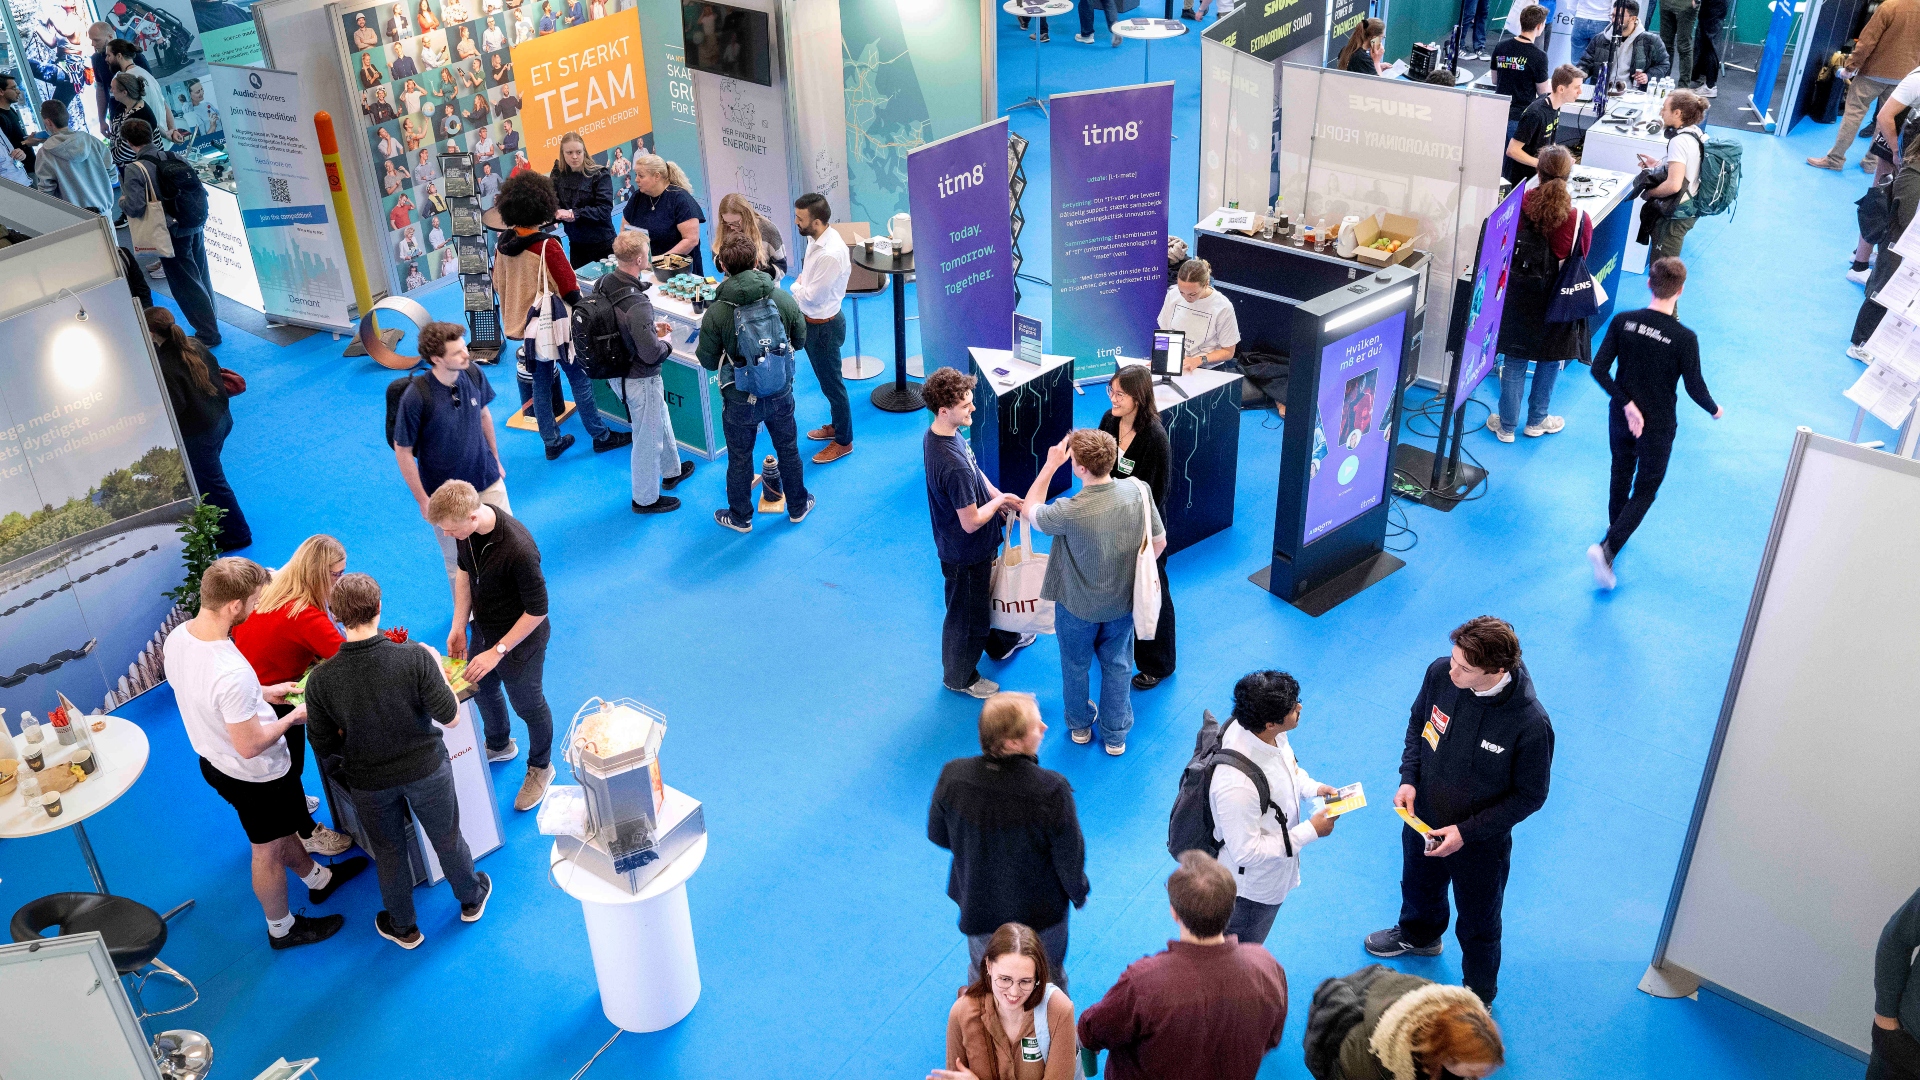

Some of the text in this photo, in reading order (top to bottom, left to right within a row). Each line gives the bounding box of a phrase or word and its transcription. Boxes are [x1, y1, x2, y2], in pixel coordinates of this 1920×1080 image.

[1250, 12, 1312, 53] EXTRAORDINARY SOUND
[530, 35, 630, 87] ET STÆRKT
[665, 52, 675, 62] VIA
[1506, 56, 1518, 64] MIX
[1497, 62, 1525, 71] MATTERS
[233, 88, 286, 103] AudioExplorers
[534, 63, 635, 131] TEAM
[230, 106, 297, 123] Join the expedition!
[671, 101, 689, 115] FOR
[578, 118, 606, 137] BEDRE
[606, 106, 639, 126] VERDEN
[721, 126, 766, 144] HER FINDER DU
[722, 136, 767, 155] ENERGINET
[1140, 191, 1160, 199] leverer
[1085, 206, 1109, 215] support,
[1109, 203, 1129, 211] stærkt
[1129, 199, 1162, 209] samarbejde
[1124, 209, 1157, 218] innovation.
[949, 223, 982, 244] Today.
[1122, 230, 1158, 239] kombination
[940, 244, 996, 274] Tomorrow.
[944, 268, 995, 296] Together.
[288, 293, 321, 308] Demant
[1345, 334, 1380, 357] Hvilken
[1339, 343, 1383, 371] m8 er du?
[28, 405, 61, 429] med
[63, 390, 103, 414] nogle
[23, 415, 91, 451] dygtigste
[27, 456, 33, 468] i
